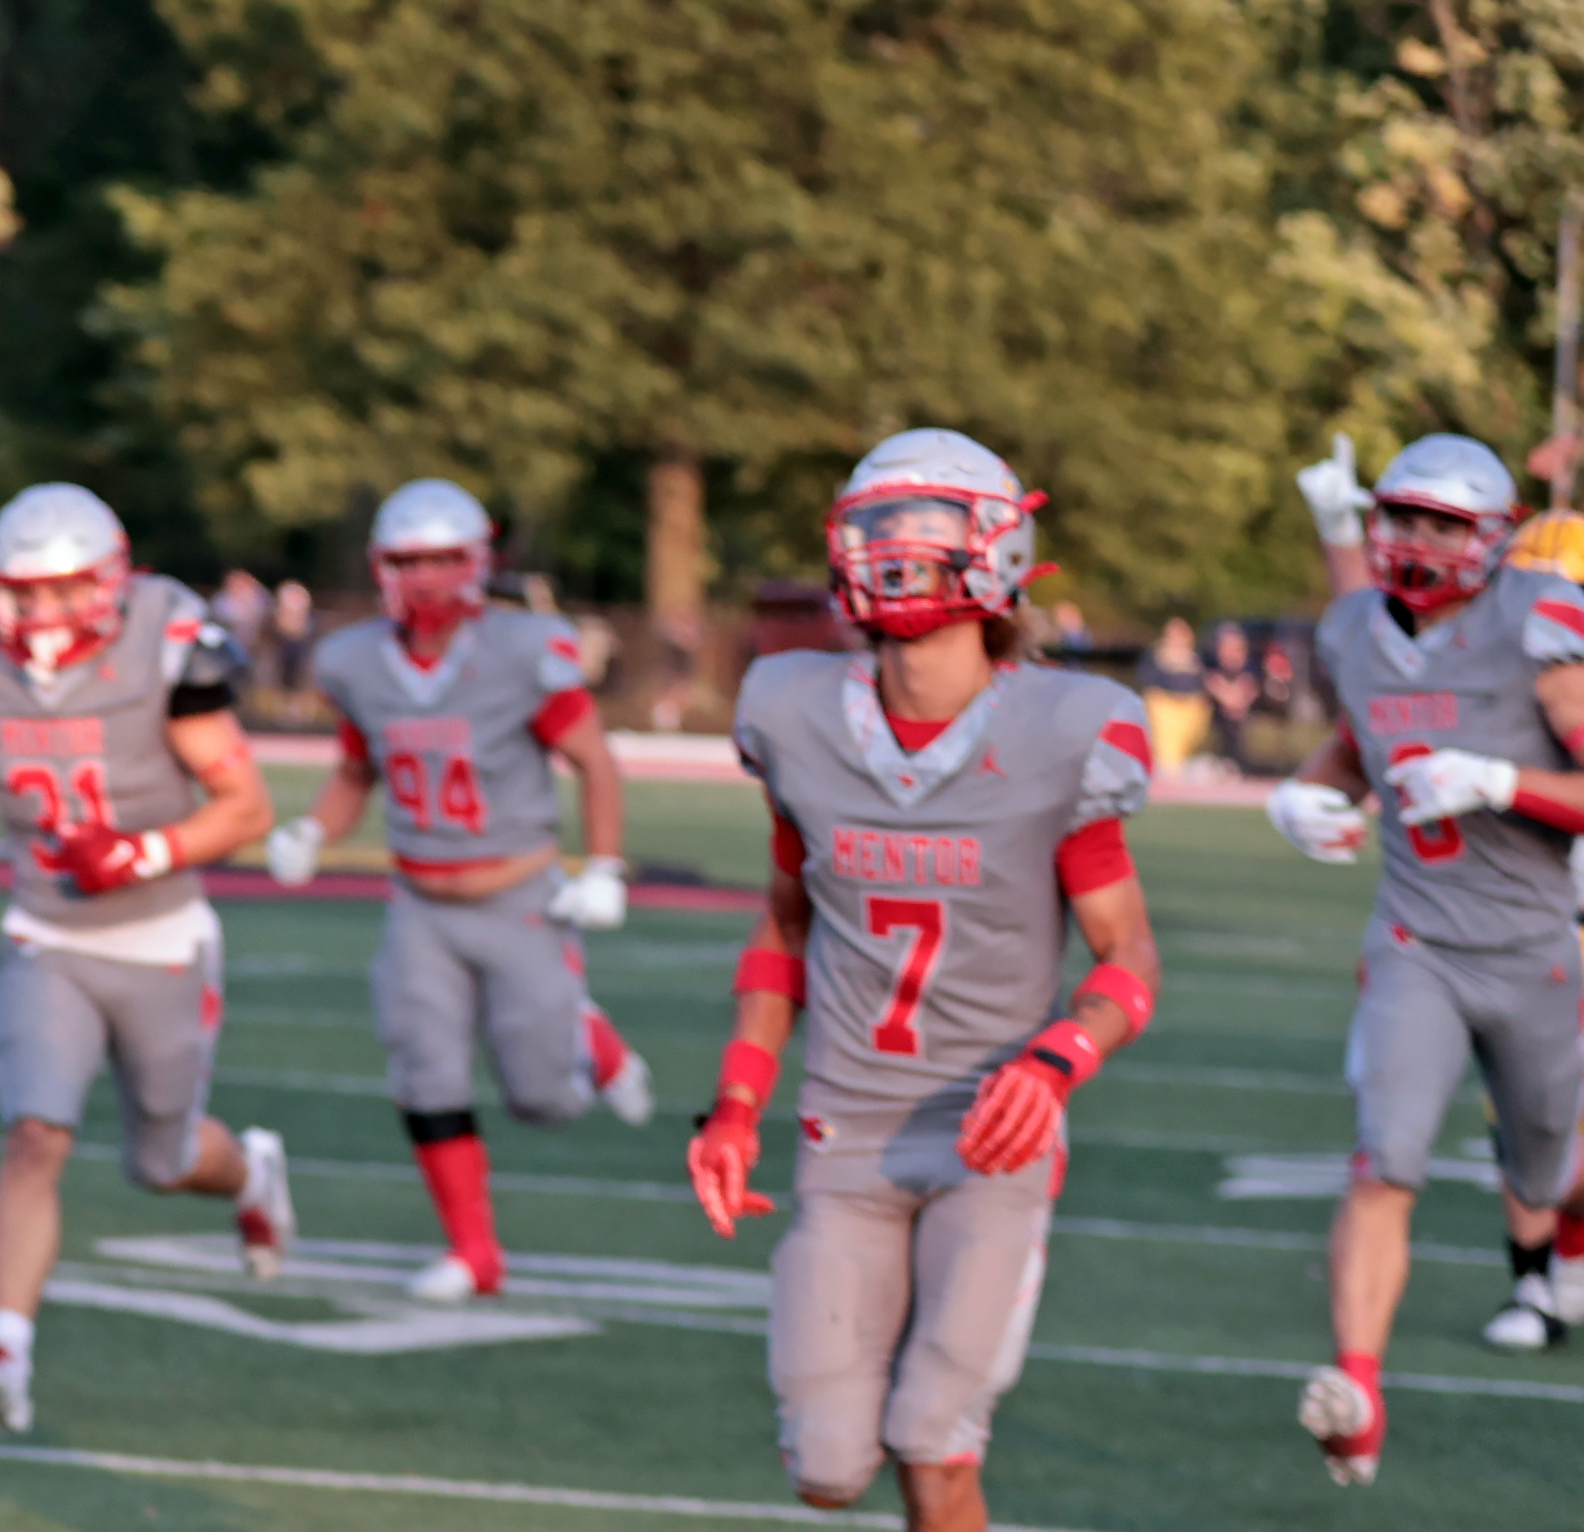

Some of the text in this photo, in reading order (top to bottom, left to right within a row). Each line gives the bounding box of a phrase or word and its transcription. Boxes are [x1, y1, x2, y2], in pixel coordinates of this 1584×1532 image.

[385, 753, 491, 836] 94
[833, 827, 983, 886] MENTOR
[864, 896, 948, 1057] 7
